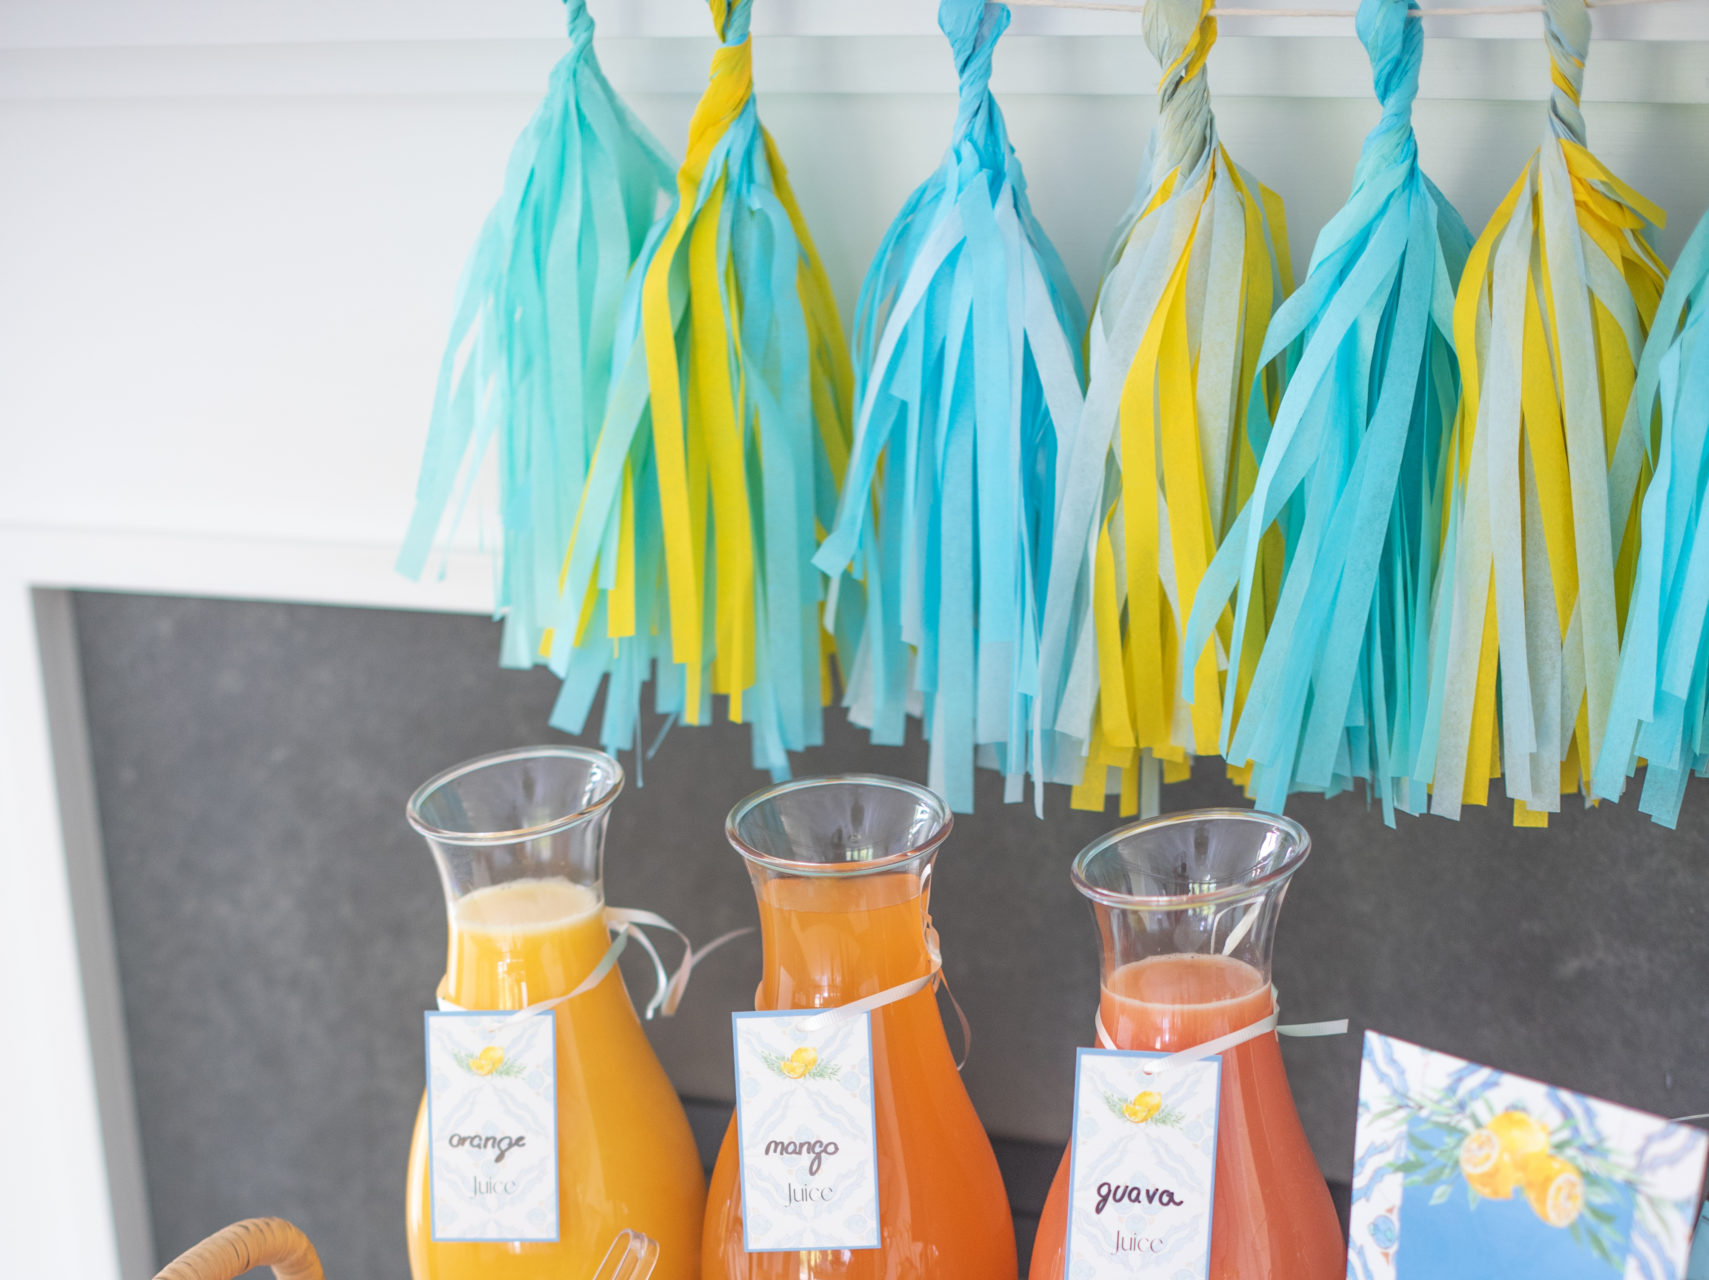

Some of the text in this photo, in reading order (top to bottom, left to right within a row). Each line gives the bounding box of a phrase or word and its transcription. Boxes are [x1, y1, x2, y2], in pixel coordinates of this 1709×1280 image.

[448, 1133, 526, 1163] orange
[765, 1140, 839, 1176] mango
[470, 1176, 517, 1199] Juice
[785, 1183, 833, 1207] Juice
[1095, 1182, 1184, 1214] guava
[1111, 1230, 1163, 1255] Juice
